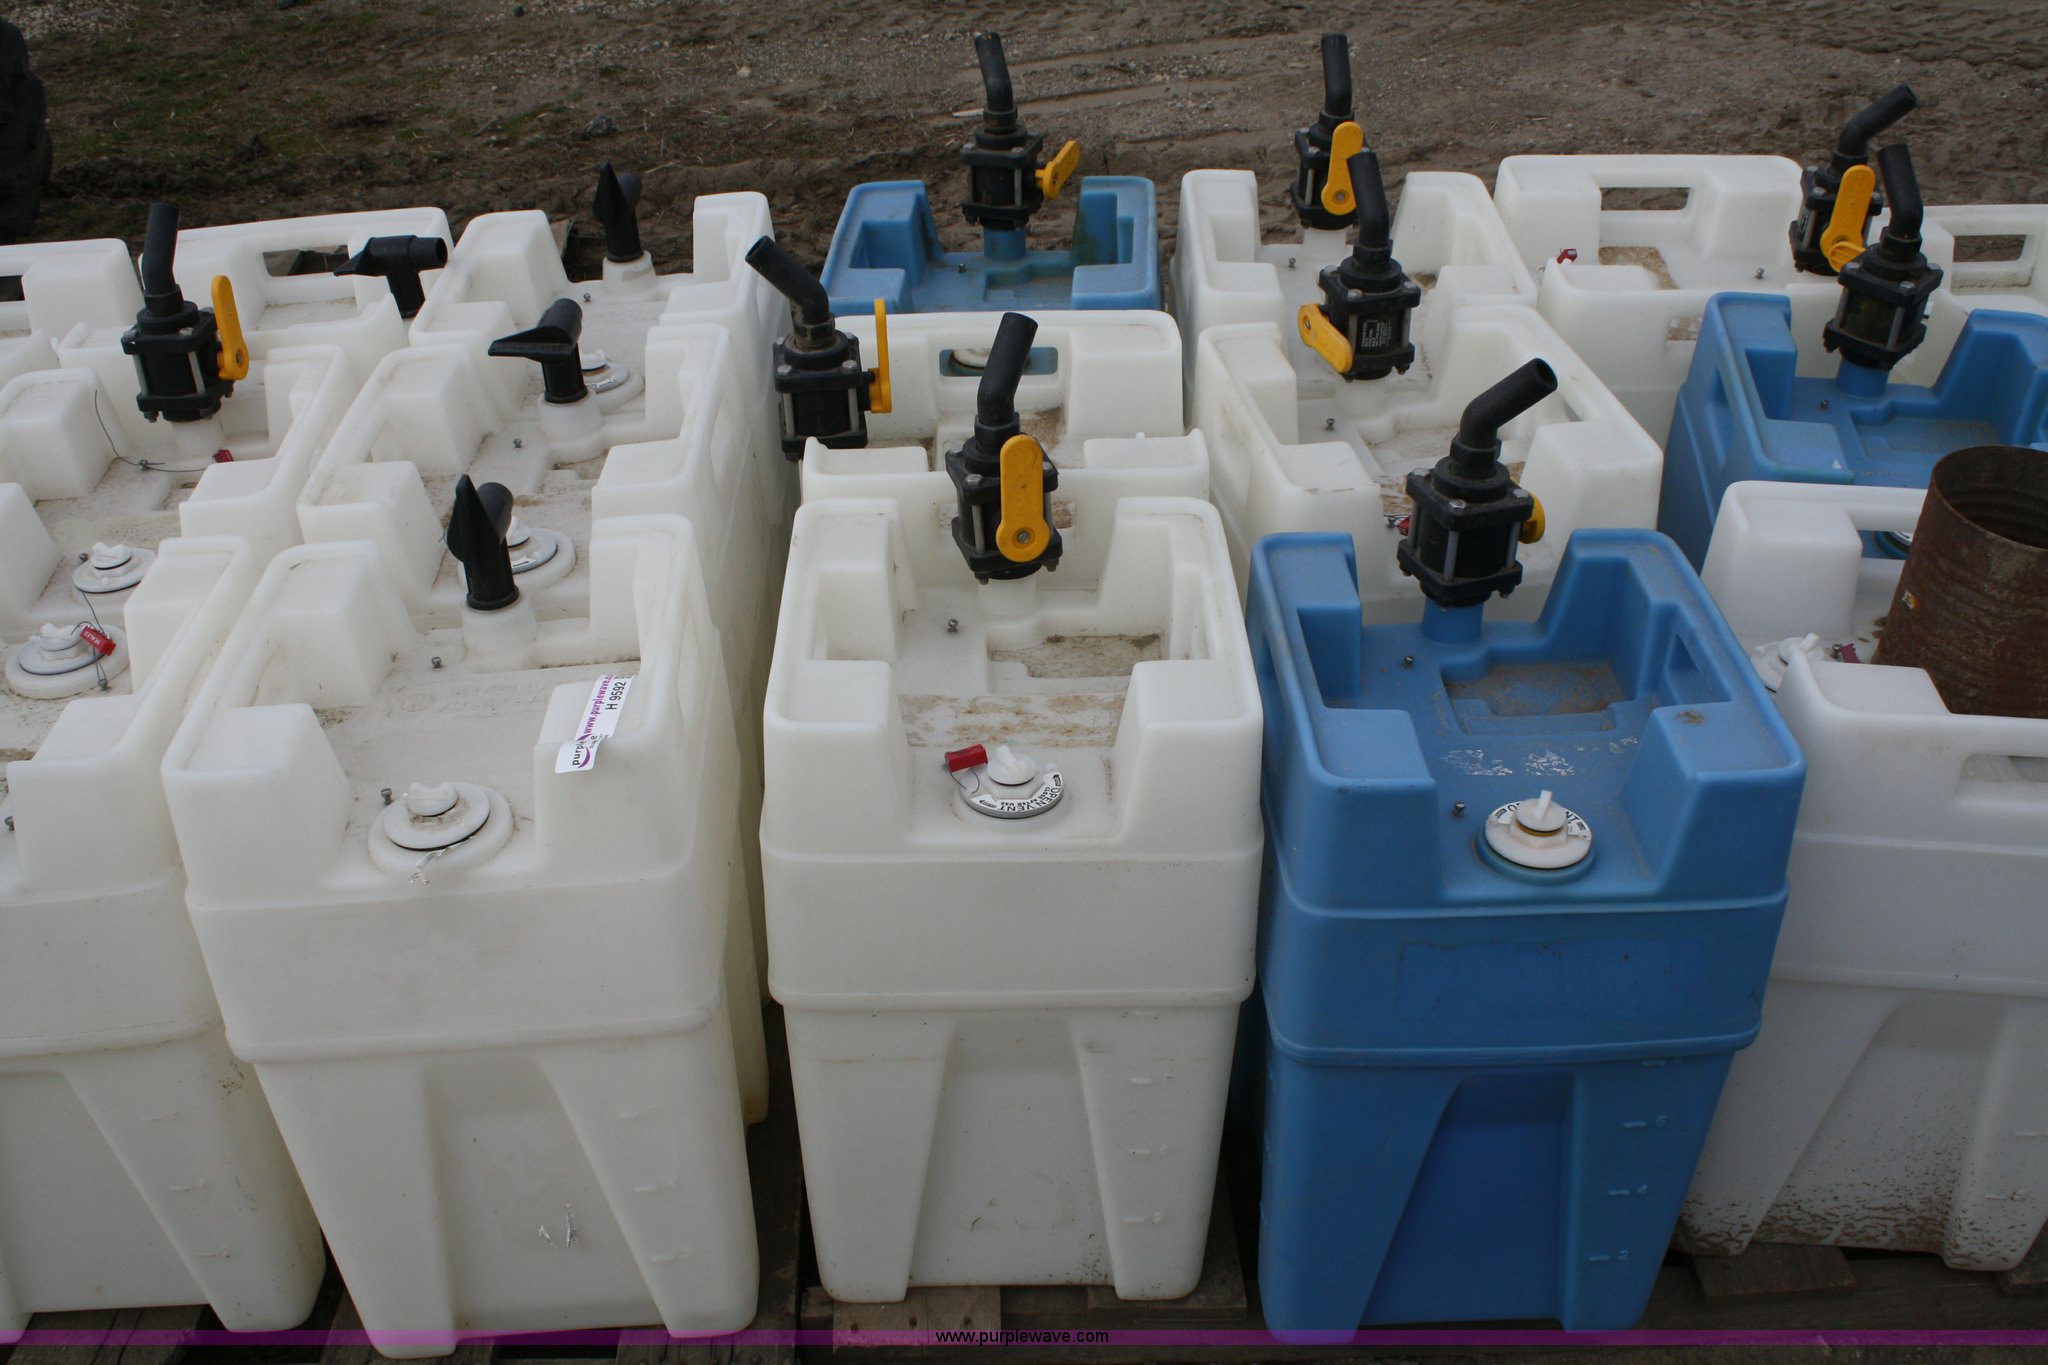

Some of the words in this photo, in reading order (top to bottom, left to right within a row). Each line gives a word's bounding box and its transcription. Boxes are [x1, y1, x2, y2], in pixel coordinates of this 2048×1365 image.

[609, 681, 627, 701] 9592
[1034, 787, 1060, 807] OPEN
[997, 804, 1035, 812] VENT
